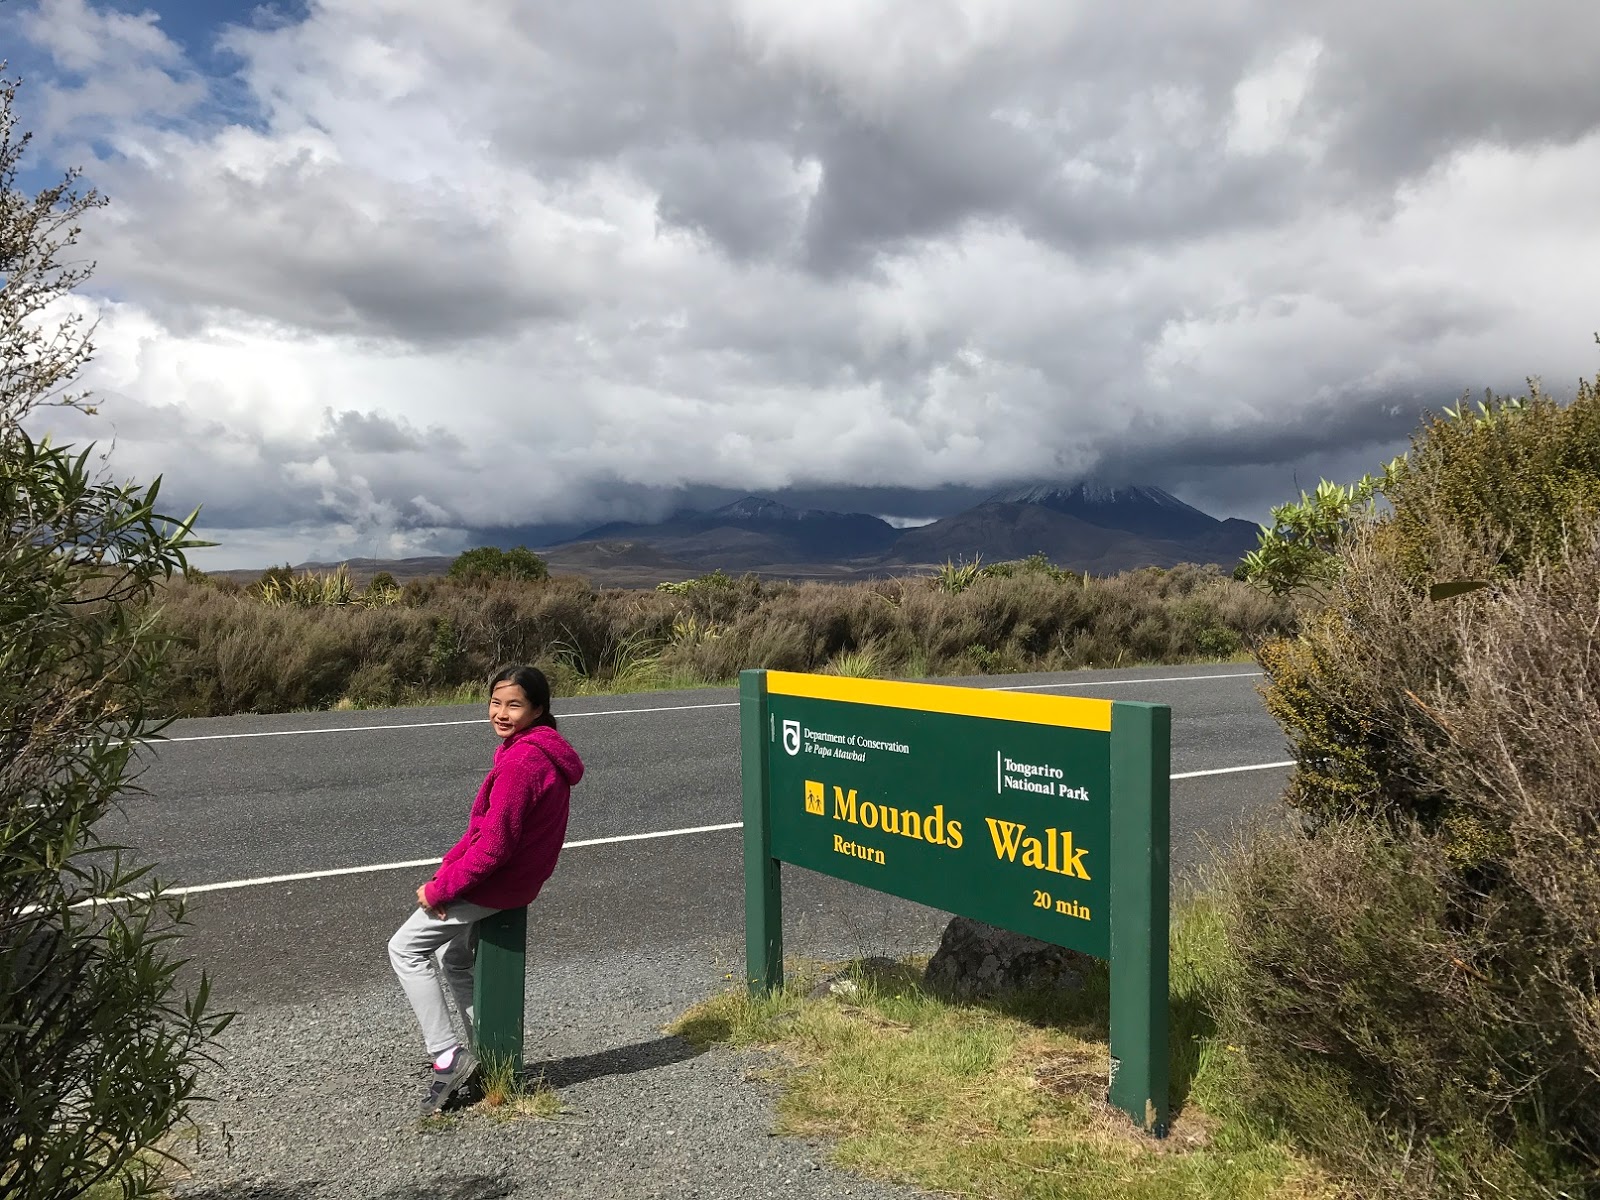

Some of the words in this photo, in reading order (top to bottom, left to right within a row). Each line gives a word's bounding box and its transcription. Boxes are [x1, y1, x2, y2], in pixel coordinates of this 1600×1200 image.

[804, 727, 846, 744] Department
[847, 735, 856, 745] of
[857, 736, 910, 754] Conservation
[804, 742, 813, 753] Te
[813, 744, 832, 758] Papa
[1004, 758, 1063, 779] Tongariro
[1004, 775, 1055, 795] National
[1058, 783, 1090, 801] Park
[833, 786, 964, 849] Mounds
[985, 818, 1091, 880] Walk
[834, 834, 886, 865] Return
[1033, 890, 1052, 910] 20
[1056, 900, 1091, 920] min
